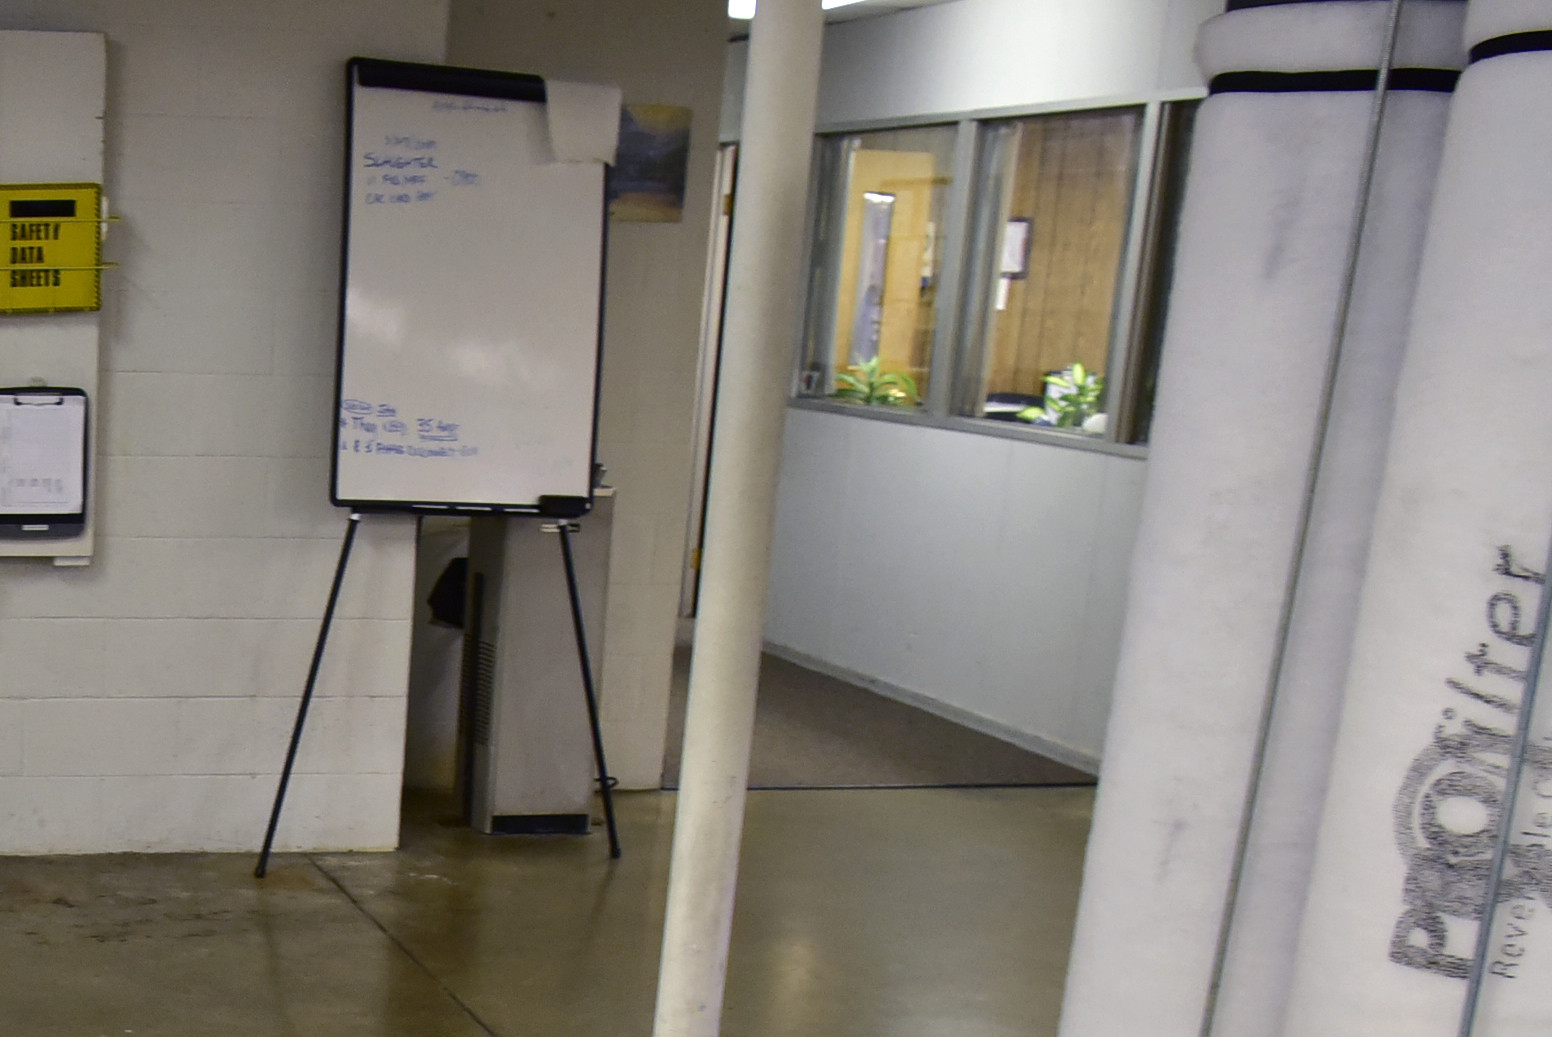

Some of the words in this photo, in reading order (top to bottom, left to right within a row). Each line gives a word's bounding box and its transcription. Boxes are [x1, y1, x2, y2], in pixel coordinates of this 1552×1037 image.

[10, 223, 61, 241] SAFETY
[10, 246, 45, 264] DATA
[10, 269, 61, 287] SHEETS
